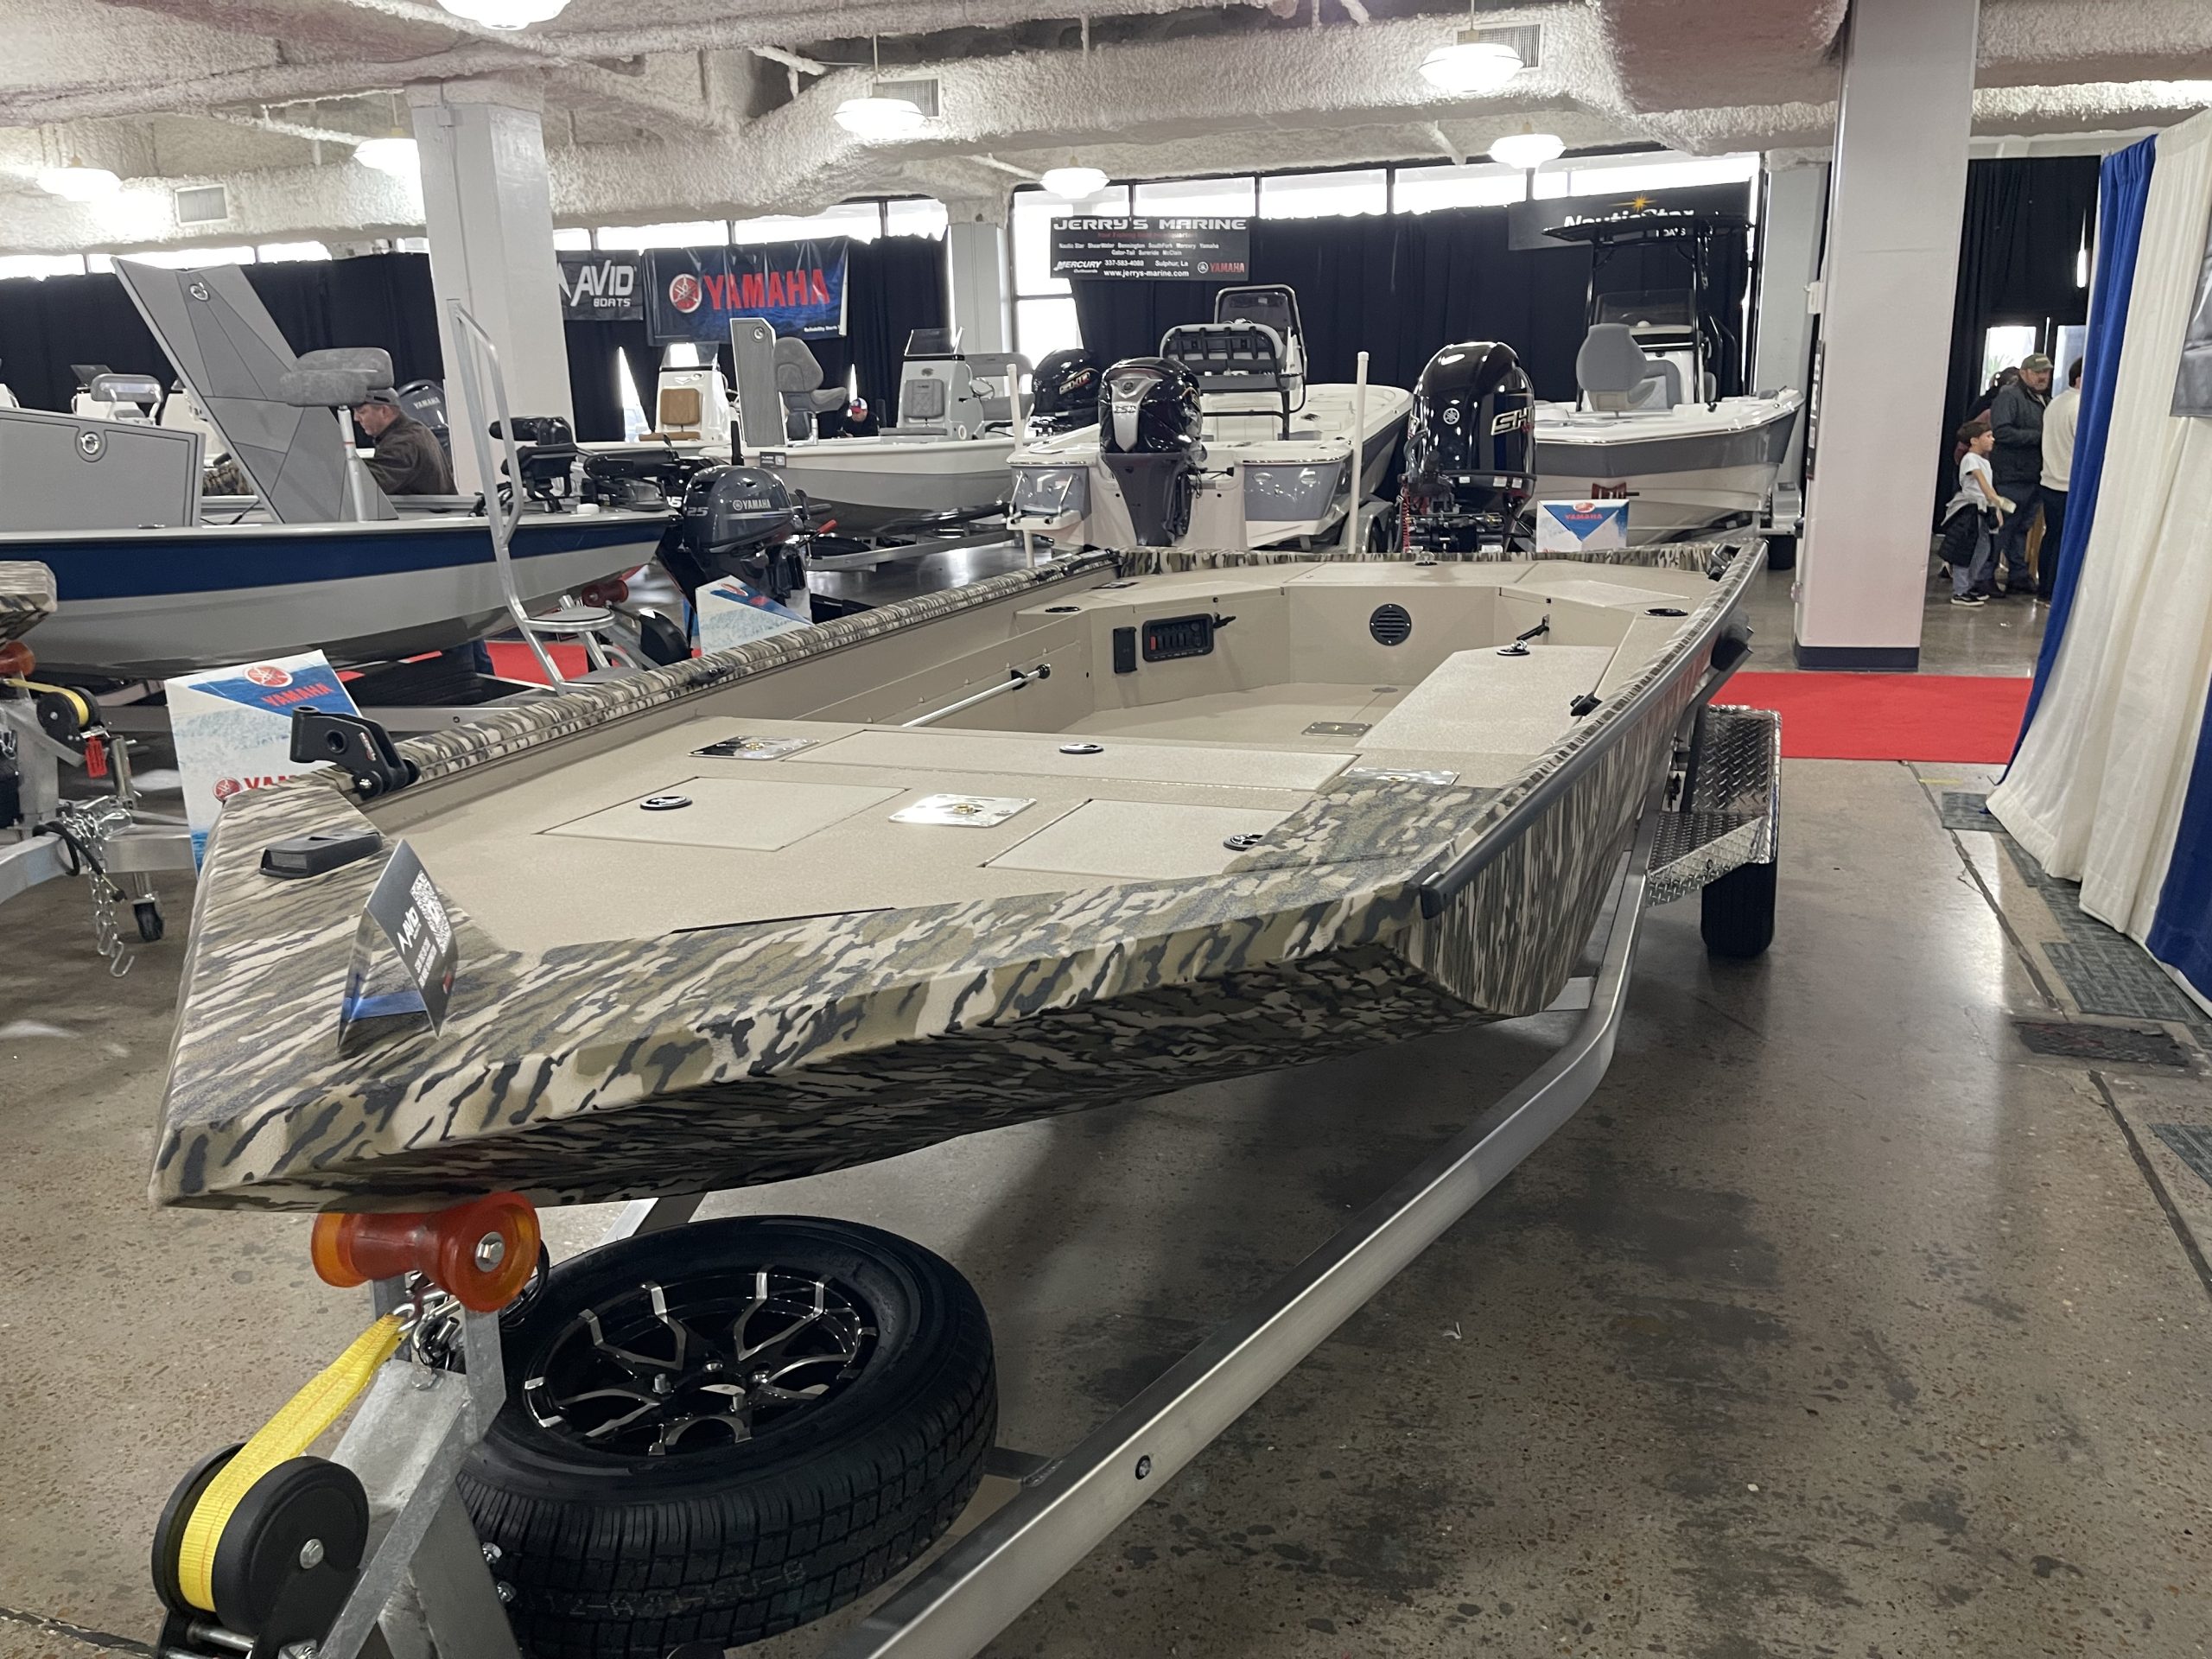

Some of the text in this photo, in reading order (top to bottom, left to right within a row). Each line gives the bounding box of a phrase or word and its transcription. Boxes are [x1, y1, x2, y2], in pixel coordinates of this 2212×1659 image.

[1053, 217, 1247, 230] JERRY'S MARINE
[1053, 261, 1102, 271] MERCURY
[1210, 262, 1245, 273] YAMAHA
[570, 259, 634, 307] AVID
[703, 269, 830, 311] YAMAHA
[593, 298, 632, 308] BOATS
[413, 397, 441, 410] YAMAHA
[743, 499, 772, 510] YAMAHA
[687, 506, 709, 517] 25
[261, 682, 334, 707] YAMAHA
